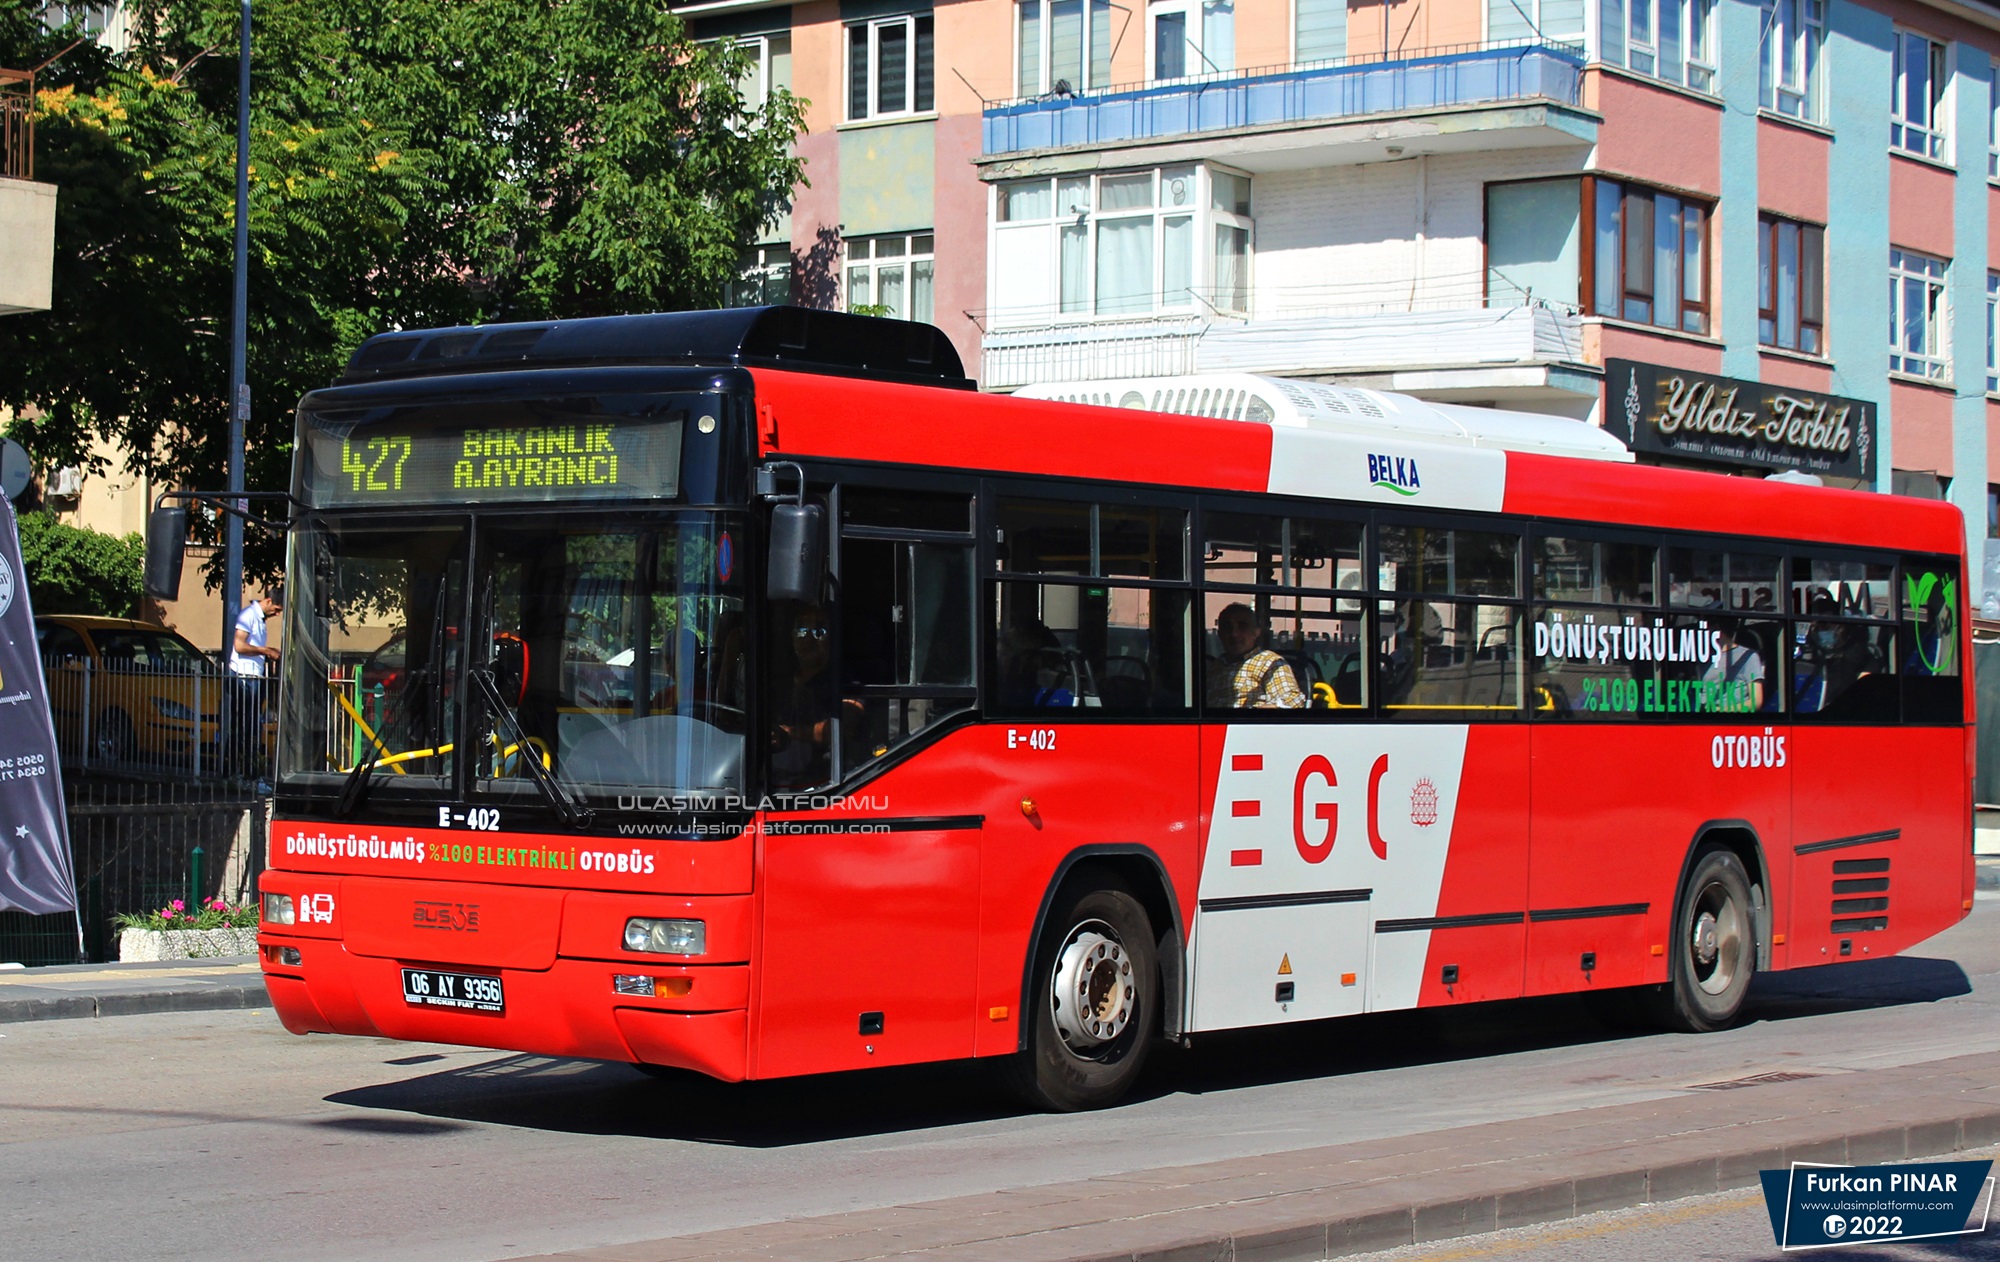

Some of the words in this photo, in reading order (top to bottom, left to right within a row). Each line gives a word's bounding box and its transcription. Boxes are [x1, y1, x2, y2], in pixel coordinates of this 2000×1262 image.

[1658, 375, 1757, 438] Yıldız
[1765, 394, 1850, 452] Tesbih
[463, 423, 615, 457] BAKANLIK
[342, 436, 411, 491] 427
[454, 455, 618, 488] A.AYRANCI
[1367, 453, 1420, 488] BELKA
[1535, 613, 1721, 668] DÖNÜŞTÜRÜLMÜŞ
[1582, 677, 1639, 713] %100
[1008, 729, 1056, 750] E-402
[1711, 727, 1786, 769] OTOBÜS
[286, 836, 425, 864] DÖNÜŞTÜRÜLMÜŞ
[429, 844, 473, 864] %100
[477, 845, 576, 871] ELEKTRİKLİ
[580, 849, 655, 875] OTOBÜS
[411, 973, 430, 994] 06
[439, 975, 454, 997] AY
[464, 978, 500, 1002] 9356
